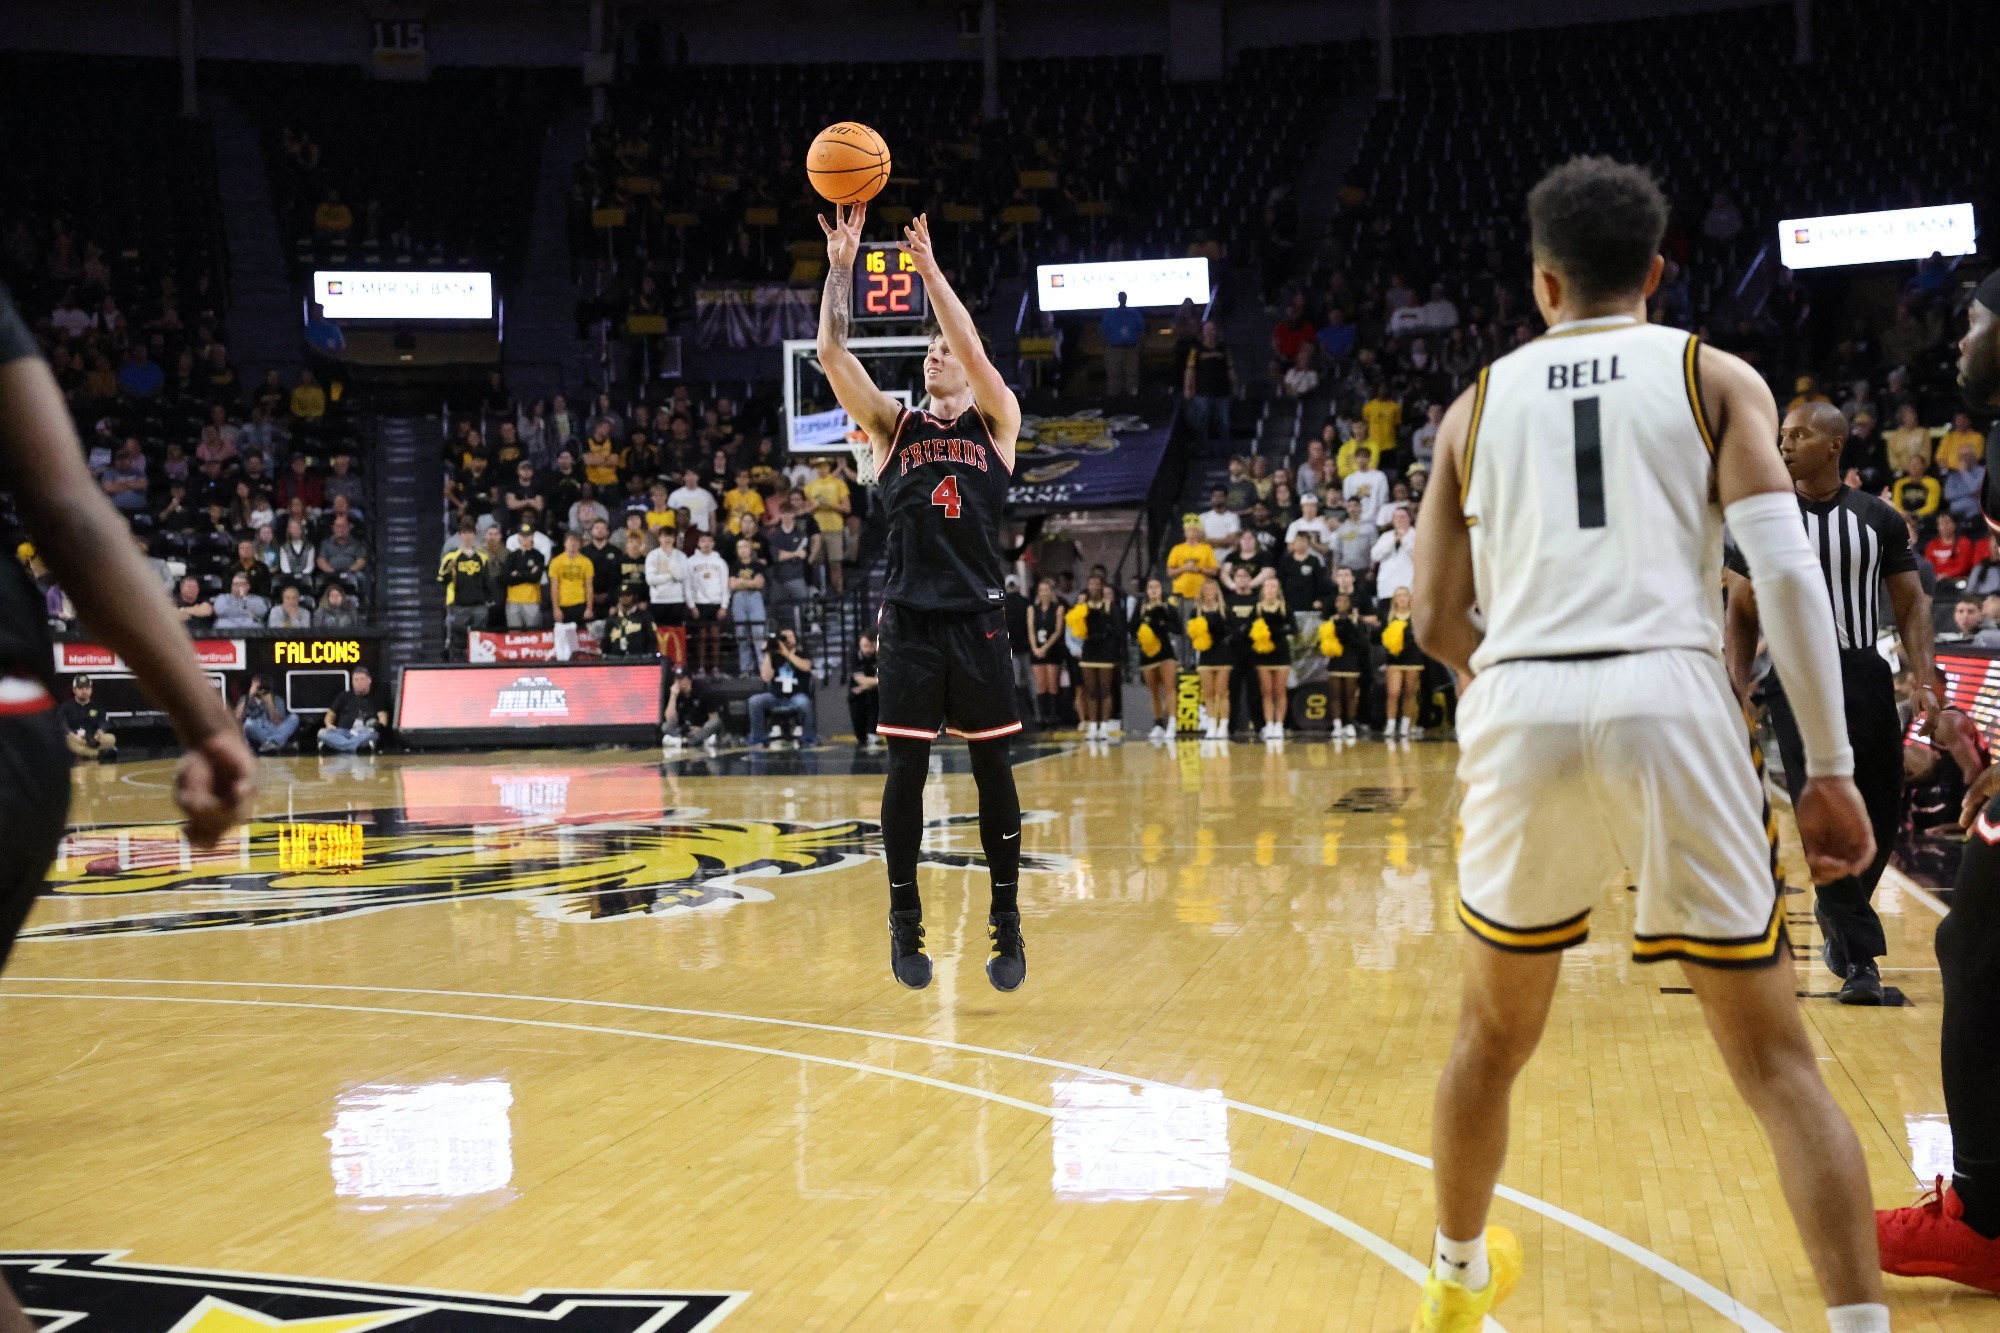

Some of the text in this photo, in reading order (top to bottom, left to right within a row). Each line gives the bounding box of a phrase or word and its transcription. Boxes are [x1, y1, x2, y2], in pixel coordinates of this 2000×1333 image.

[375, 23, 425, 53] 115
[1820, 217, 1960, 241] EMPRSE BANK
[866, 251, 886, 273] 16
[350, 282, 478, 294] EMPRSE BANK
[866, 273, 912, 312] 22
[1072, 273, 1139, 284] EMPRSE
[1548, 355, 1626, 391] BELL
[899, 438, 988, 476] FRIENDS
[1573, 396, 1606, 529] 1
[932, 475, 962, 518] 4
[275, 641, 360, 664] FALCONS
[505, 634, 538, 645] Lane
[1177, 674, 1200, 732] NOISE
